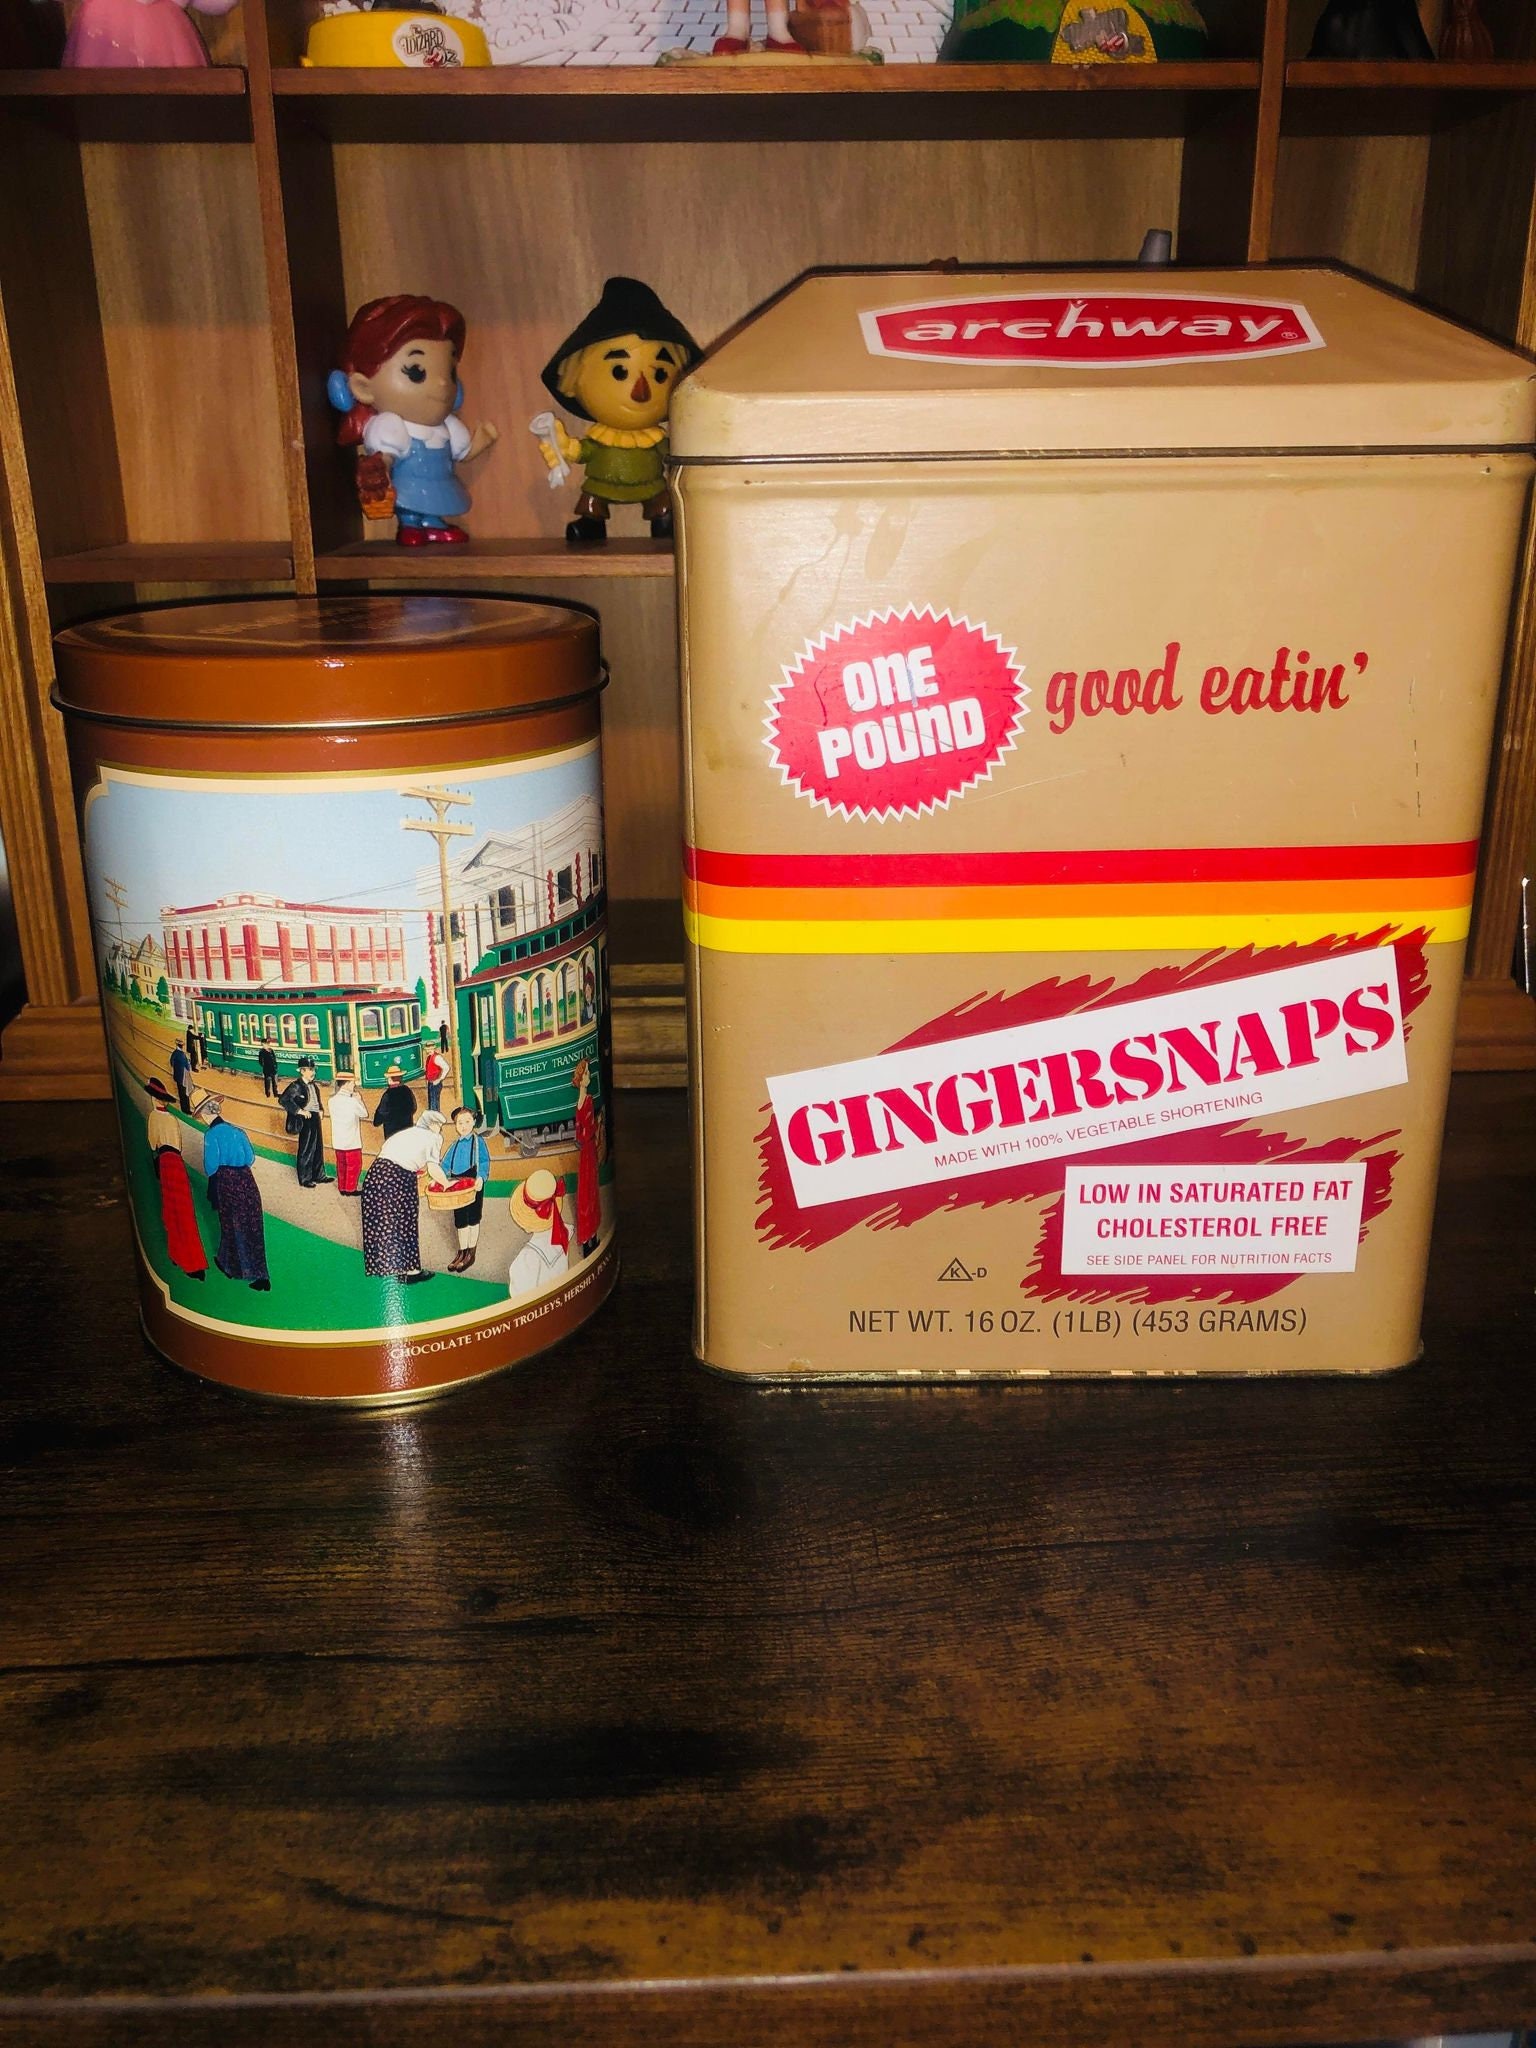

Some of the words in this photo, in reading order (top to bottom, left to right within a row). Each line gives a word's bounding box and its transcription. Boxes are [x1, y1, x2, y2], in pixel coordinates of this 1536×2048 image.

[903, 299, 1284, 342] archway
[842, 646, 940, 713] ONE
[1045, 641, 1184, 735] good
[818, 697, 986, 779] POUND
[505, 1060, 548, 1079] HERSHEY
[552, 1048, 585, 1068] TRANSIT
[788, 983, 1396, 1168] GINGERSNAPS
[934, 1149, 978, 1168] MADE
[981, 1139, 1021, 1158] WITH
[1025, 1132, 1063, 1150] 100%
[1066, 1113, 1155, 1142] VEGETABLE
[1160, 1091, 1264, 1123] SHORTENING
[1079, 1183, 1130, 1205] LOW
[1138, 1183, 1162, 1204] IN
[1169, 1181, 1304, 1203] SATURATED
[1312, 1180, 1353, 1201] FAT
[1096, 1218, 1262, 1239] CHOLESTEROL
[1270, 1216, 1328, 1236] FREE
[1086, 1255, 1110, 1266] SEE
[1113, 1255, 1143, 1266] SIDE
[1147, 1254, 1188, 1266] PANEL
[1191, 1254, 1217, 1265] FOR
[1220, 1253, 1290, 1265] NUTRITION
[1293, 1252, 1332, 1264] FACTS
[391, 1334, 472, 1359] CHOCOLATE
[476, 1321, 511, 1342] TOWN
[513, 1297, 563, 1328] TROLLEYS,
[564, 1272, 598, 1303] HERSHEY,
[849, 1310, 900, 1333] NET
[907, 1310, 953, 1333] WT.
[965, 1310, 994, 1333] 16
[1001, 1310, 1041, 1333] OZ.
[1052, 1309, 1121, 1338] (1LB)
[1132, 1309, 1190, 1337] (453
[1198, 1308, 1307, 1335] GRAMS)
